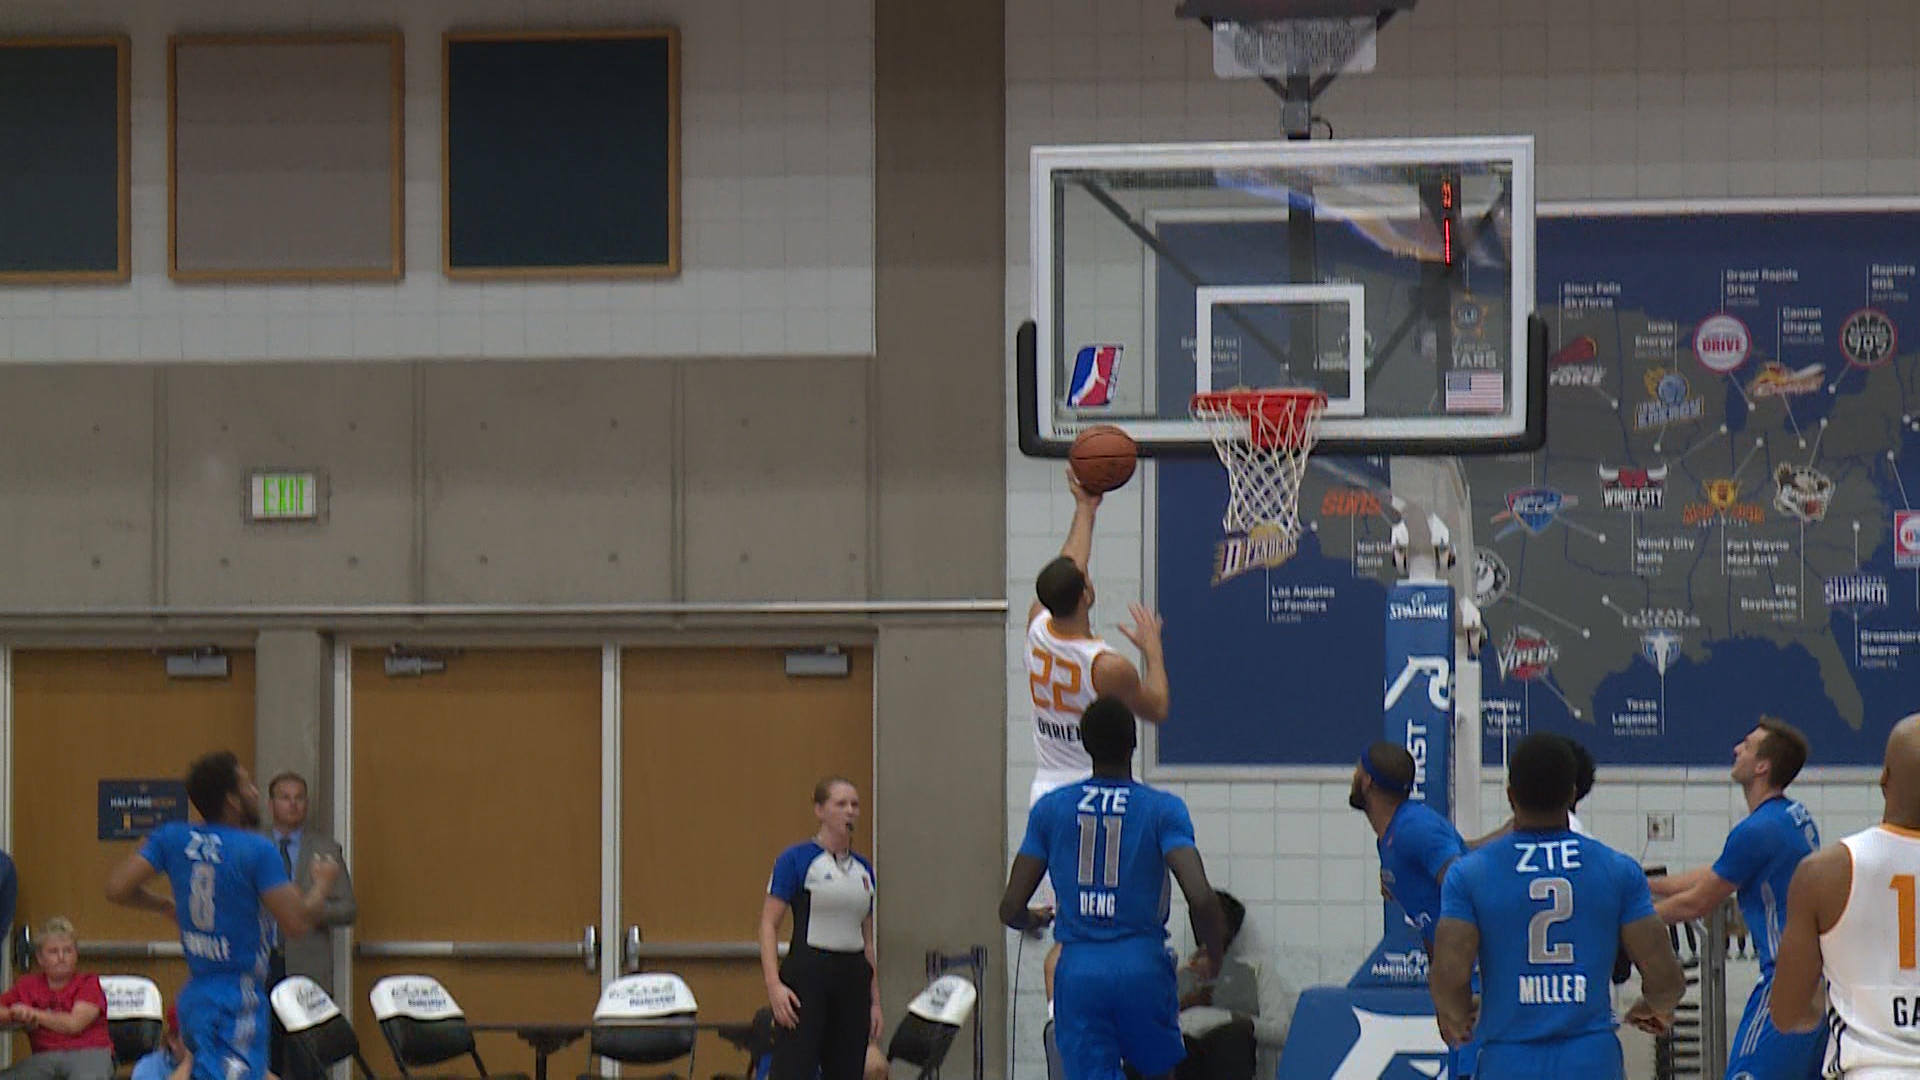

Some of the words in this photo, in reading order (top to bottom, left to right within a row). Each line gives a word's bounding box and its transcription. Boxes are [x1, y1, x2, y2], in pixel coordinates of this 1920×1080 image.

[1702, 339, 1742, 354] DRIVE
[264, 477, 306, 512] EXIT
[1602, 487, 1638, 508] WINDY
[1640, 487, 1664, 509] CITY
[1271, 584, 1291, 598] Los
[1293, 584, 1336, 599] Angeles
[1389, 600, 1448, 621] SPALDING
[1030, 647, 1084, 715] 22
[1077, 785, 1131, 814] ZTE
[1077, 813, 1122, 888] 11
[1514, 838, 1582, 873] ZTE
[1079, 890, 1116, 918] DENG
[1528, 876, 1575, 964] 2
[1518, 974, 1588, 1005] MILLER
